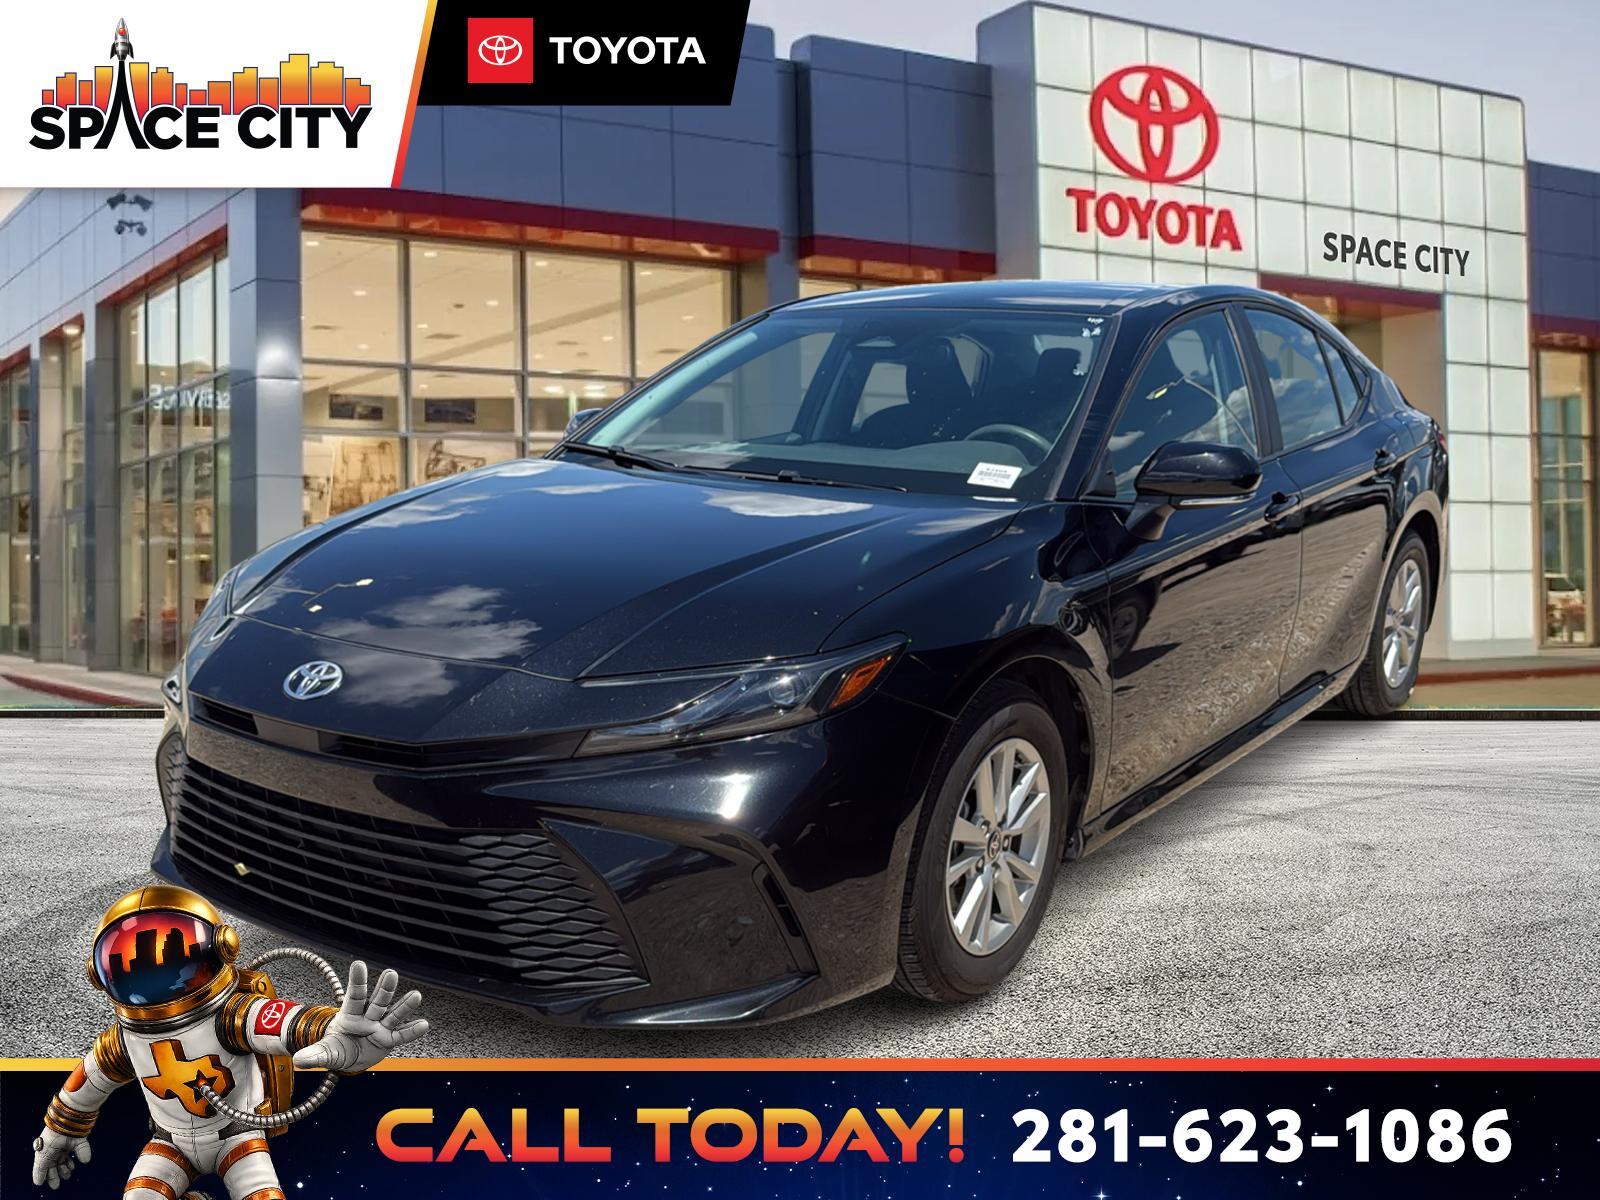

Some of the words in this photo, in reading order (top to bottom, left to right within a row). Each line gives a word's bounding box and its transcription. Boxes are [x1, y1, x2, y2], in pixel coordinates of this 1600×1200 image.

[1066, 187, 1243, 251] TOYOTA
[1322, 231, 1407, 271] SPACE
[1414, 244, 1471, 277] CITY
